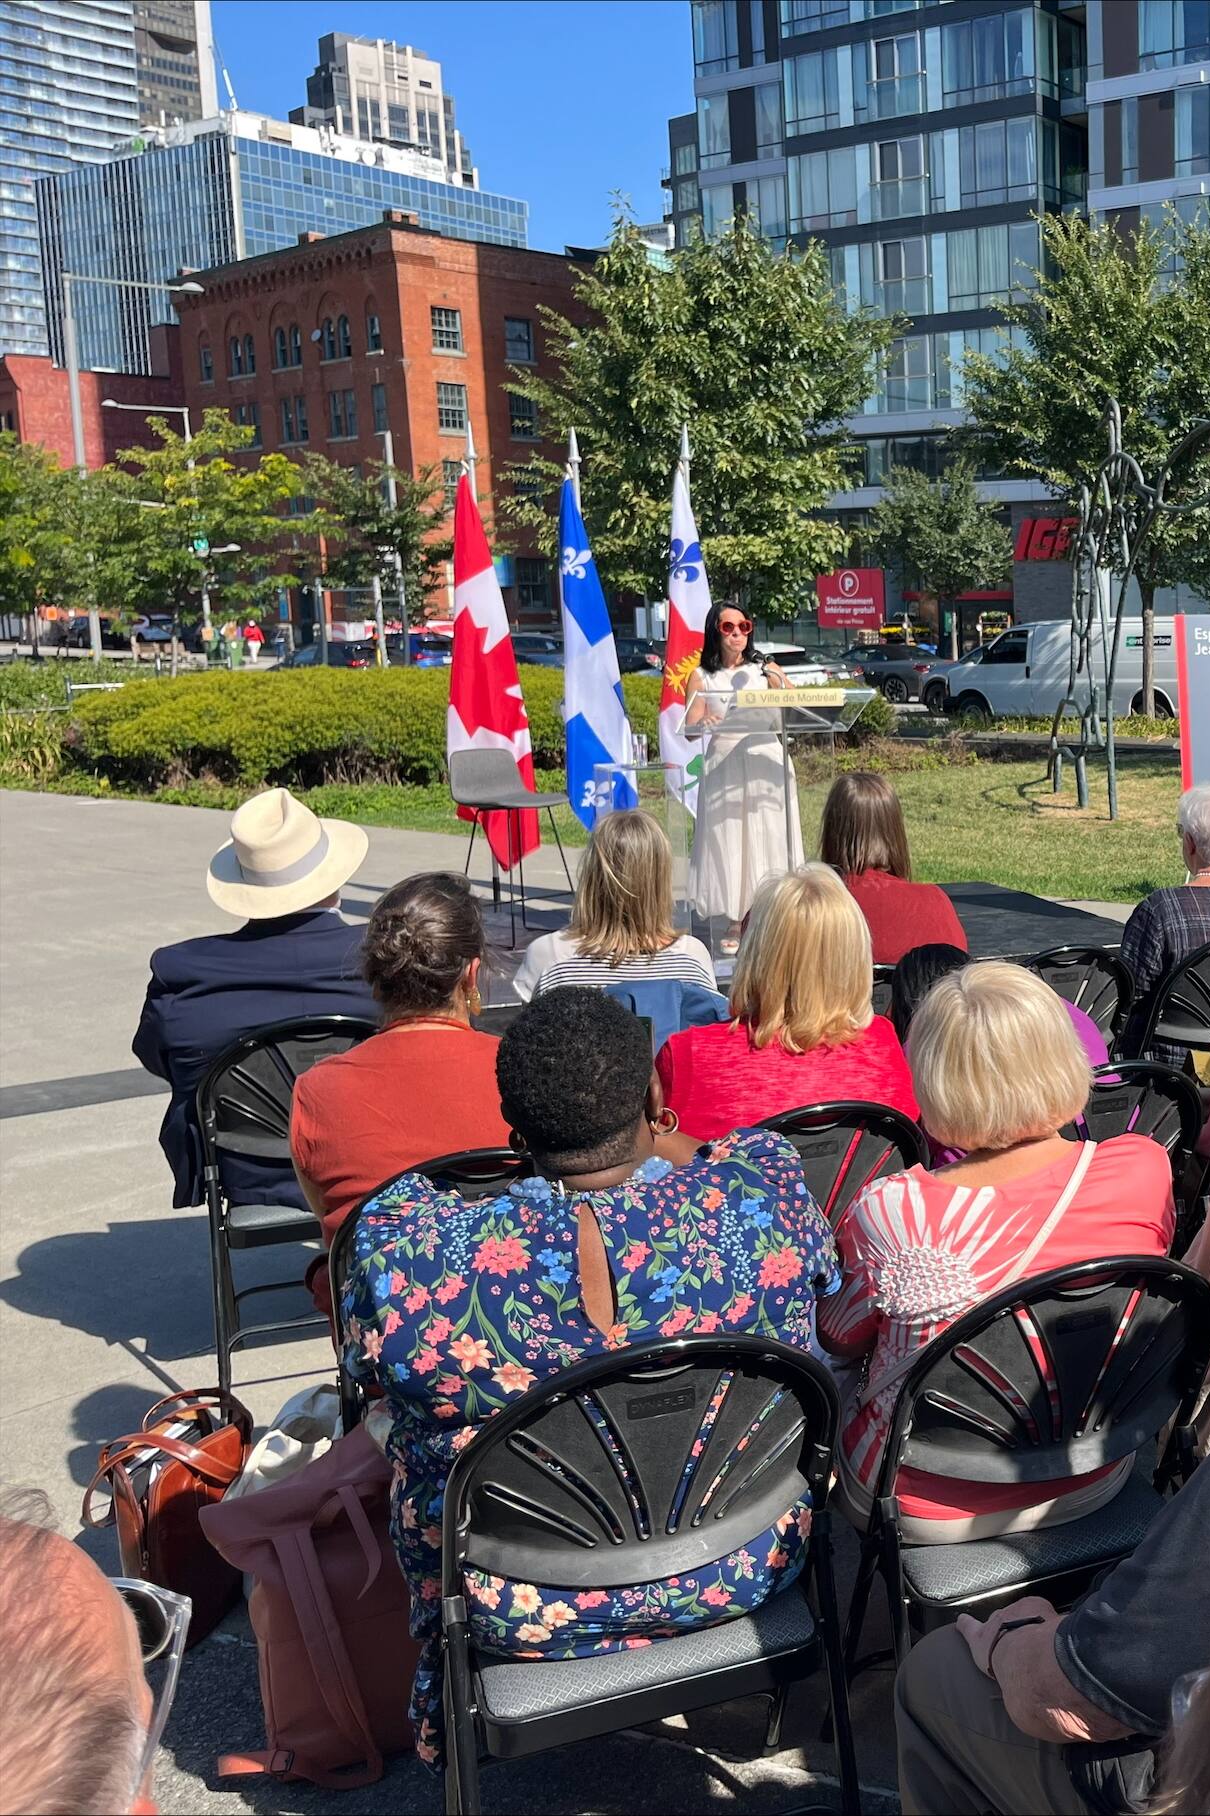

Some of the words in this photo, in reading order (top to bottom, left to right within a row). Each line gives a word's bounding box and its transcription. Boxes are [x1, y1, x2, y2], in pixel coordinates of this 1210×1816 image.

[844, 577, 854, 591] P
[826, 597, 873, 605] Stationnement
[853, 606, 875, 615] gratuit
[761, 694, 780, 703] Ville
[783, 694, 794, 703] de
[797, 693, 837, 702] Montréal
